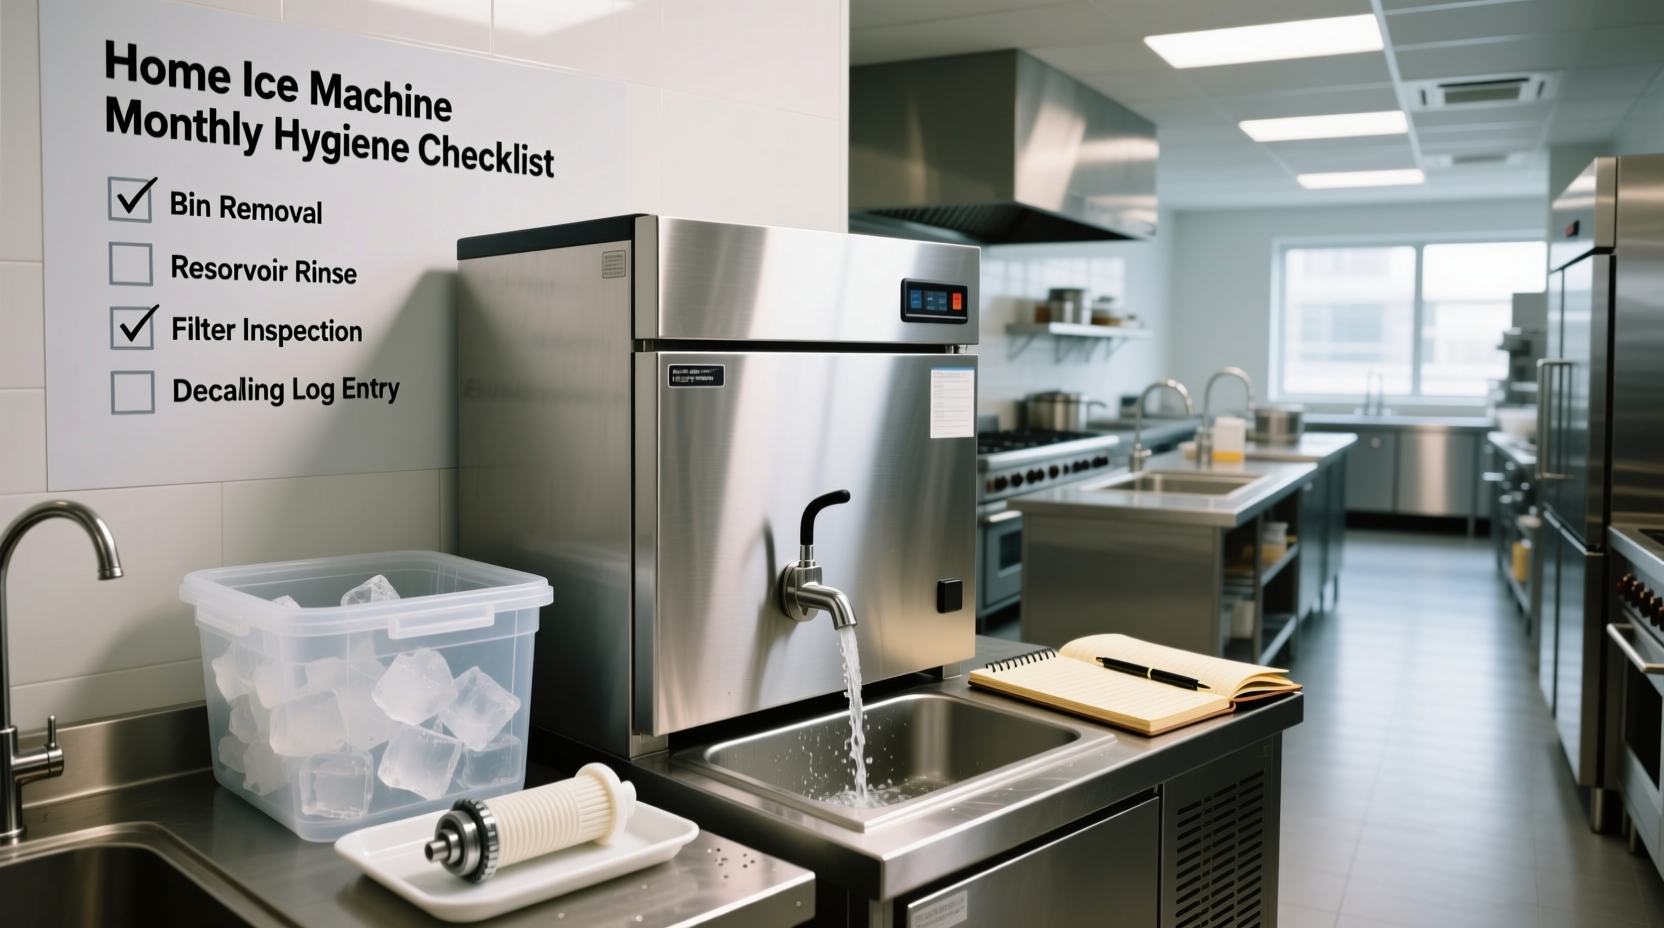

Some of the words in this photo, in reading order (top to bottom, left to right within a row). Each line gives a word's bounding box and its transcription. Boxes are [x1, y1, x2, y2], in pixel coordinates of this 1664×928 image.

[105, 39, 231, 95] Home
[243, 60, 299, 103] Ice
[310, 70, 453, 123] Machine
[105, 95, 264, 157] Monthly
[274, 116, 410, 165] Hygiene
[418, 133, 555, 179] Checklist
[170, 190, 211, 218] Bin
[220, 194, 323, 225] Removal
[171, 254, 289, 283] Resorvoir
[295, 259, 358, 285] Rinse
[172, 315, 237, 342] Filter
[243, 317, 363, 348] Inspection
[292, 377, 335, 406] Log
[342, 376, 401, 405] Entry
